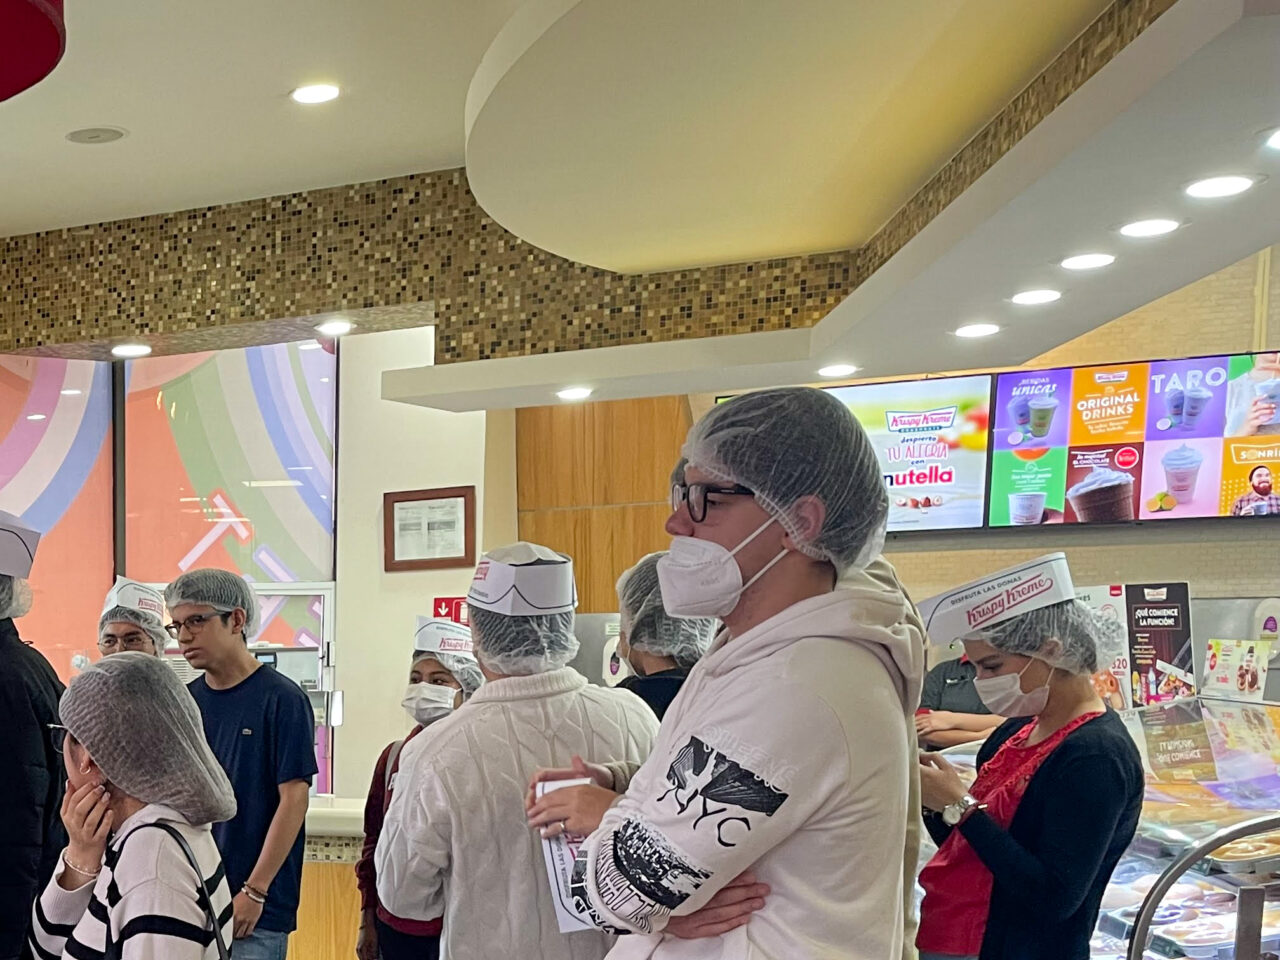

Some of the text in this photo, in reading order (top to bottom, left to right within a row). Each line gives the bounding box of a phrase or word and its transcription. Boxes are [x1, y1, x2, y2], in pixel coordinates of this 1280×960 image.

[1151, 366, 1227, 394] TARO
[1076, 392, 1140, 411] ORIGINAL
[1082, 404, 1134, 421] DRINKS
[888, 447, 901, 461] TU
[884, 466, 953, 486] nutella
[951, 576, 1022, 605] DISFRUTA LAS DONAS
[966, 573, 1053, 626] Krispy Kreme
